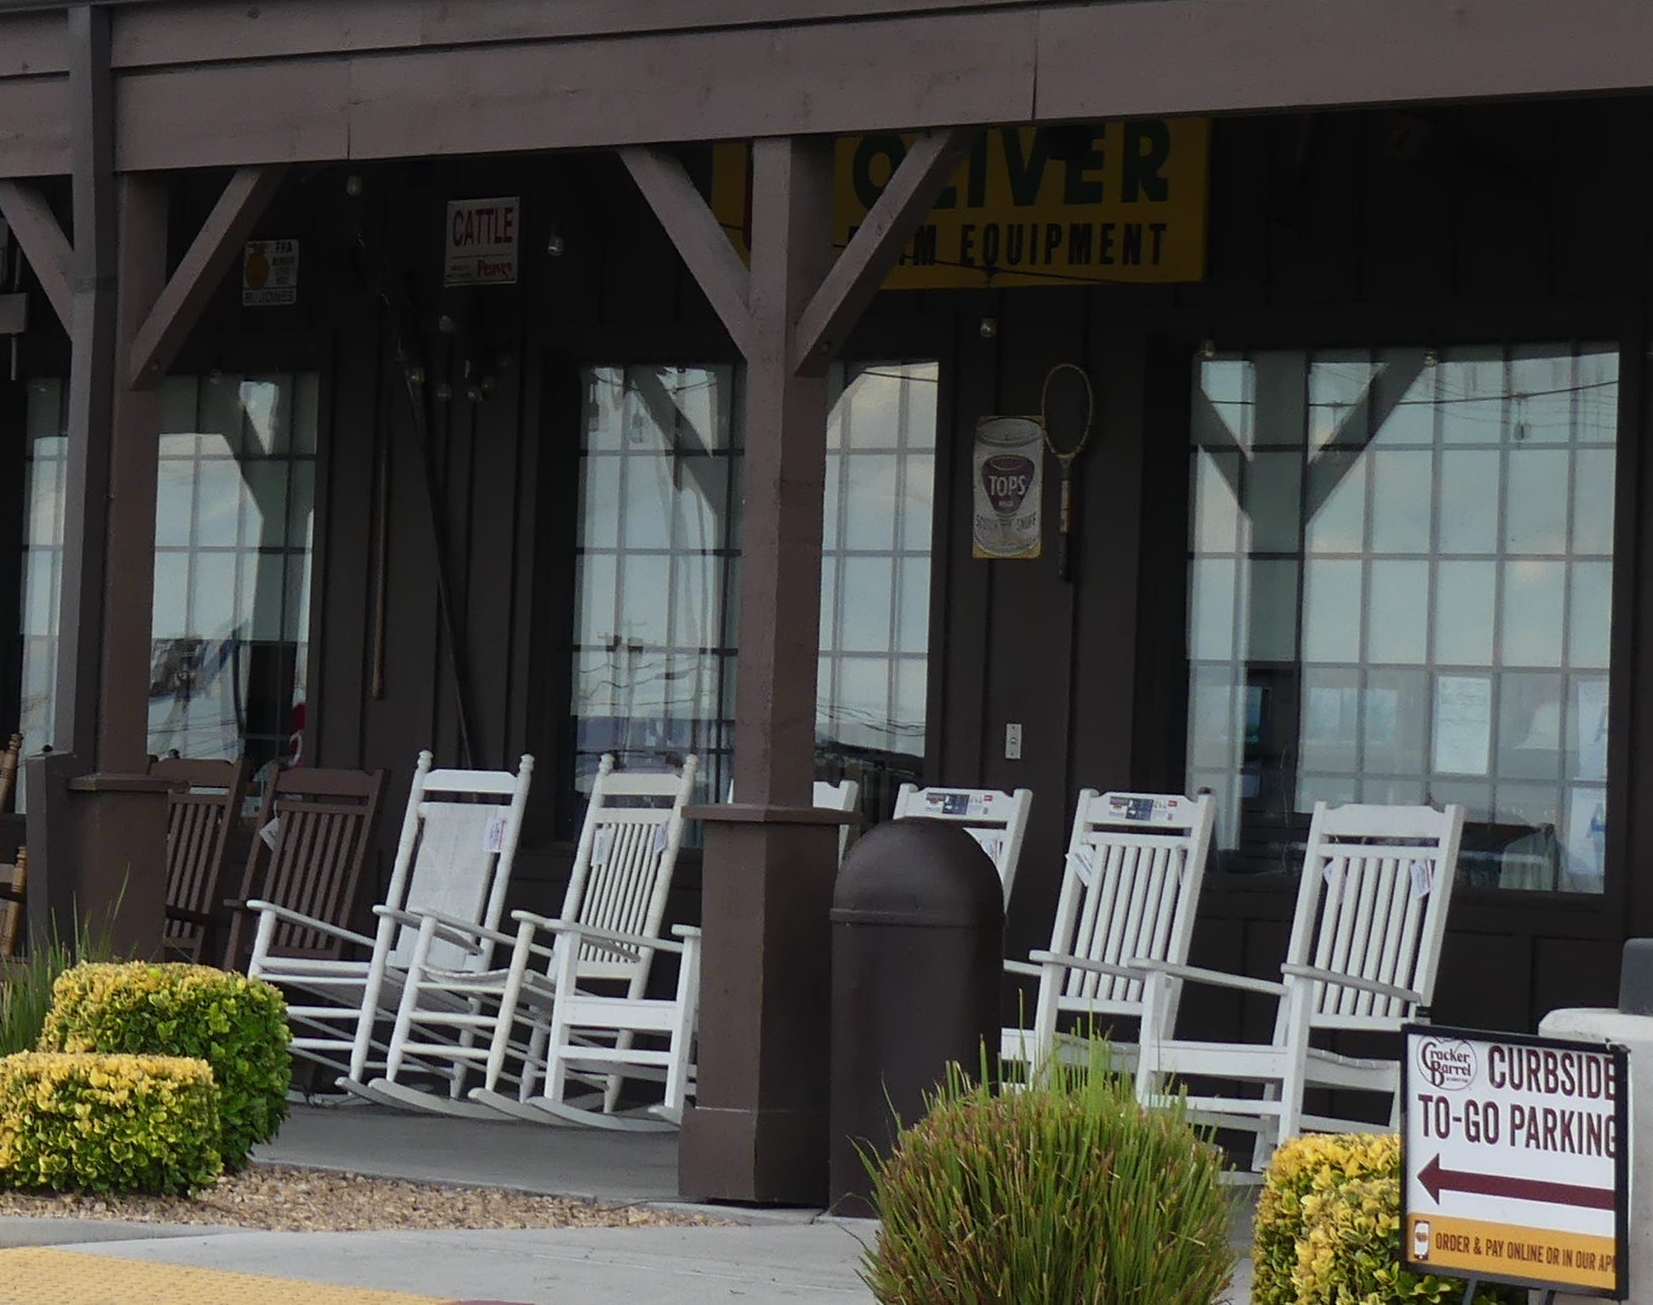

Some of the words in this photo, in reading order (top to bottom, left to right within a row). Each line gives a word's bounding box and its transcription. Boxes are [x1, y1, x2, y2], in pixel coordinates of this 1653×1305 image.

[452, 206, 515, 247] CATTLE
[961, 222, 1169, 267] EQUIPMENT
[988, 475, 1027, 496] TOPS
[1421, 1041, 1470, 1072] Cracker
[1430, 1060, 1471, 1087] Barrel
[1488, 1045, 1616, 1101] CURBSIDE
[1417, 1094, 1499, 1145] TO-GO
[1509, 1103, 1616, 1159] PARKING
[1435, 1232, 1470, 1254] ORDER
[1473, 1237, 1482, 1255] &
[1485, 1238, 1505, 1258] PAY
[1507, 1241, 1543, 1264] ONLINE
[1546, 1247, 1560, 1265] OR
[1562, 1249, 1573, 1268] IN
[1575, 1250, 1596, 1270] OUR
